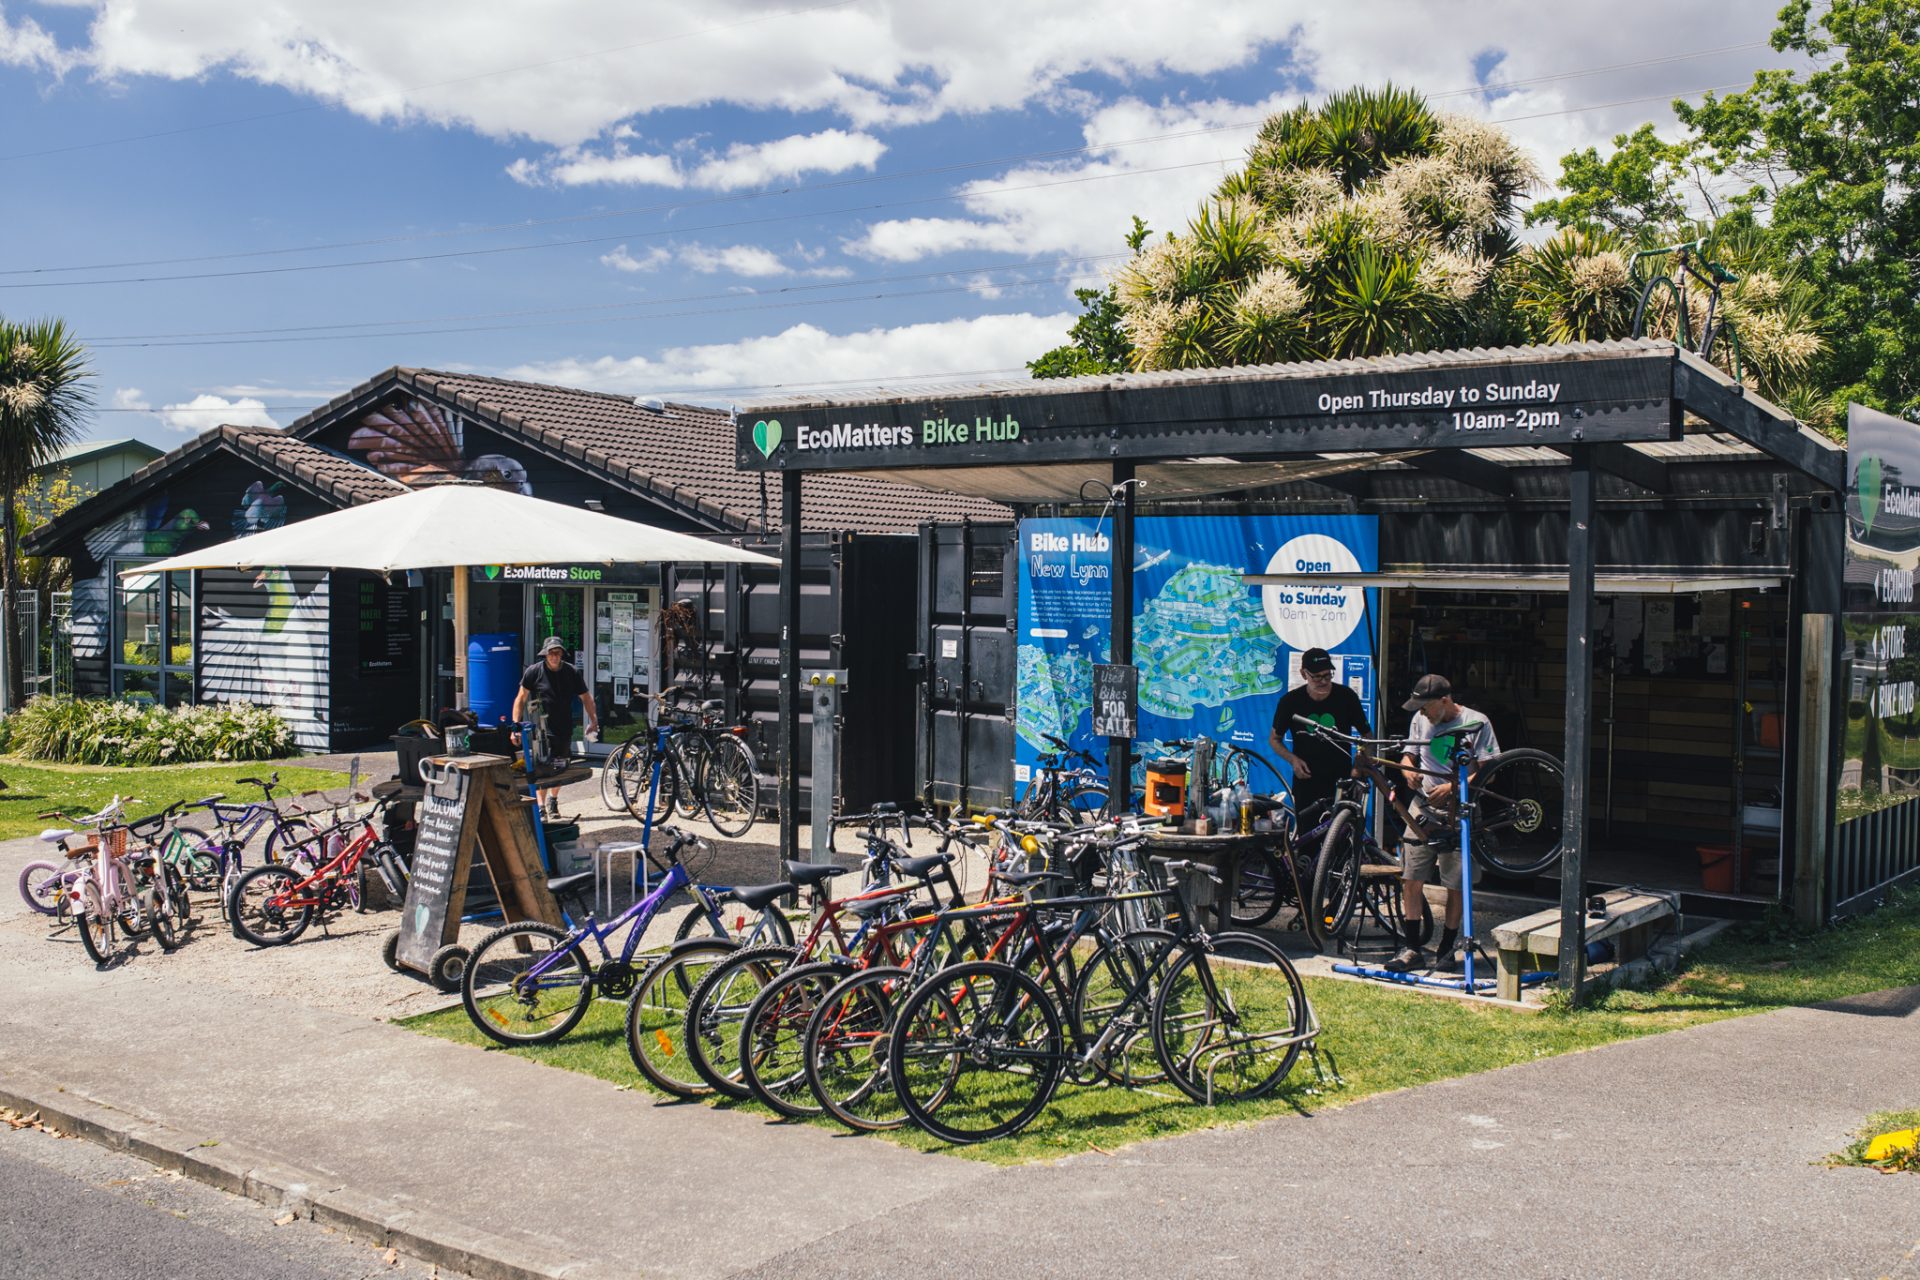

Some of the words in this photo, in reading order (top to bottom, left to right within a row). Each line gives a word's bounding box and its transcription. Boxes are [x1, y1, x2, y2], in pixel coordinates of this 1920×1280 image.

[1318, 394, 1363, 414] Open
[1369, 386, 1454, 408] Thursday
[1460, 386, 1479, 402] to
[1486, 380, 1560, 402] Sunday
[1452, 409, 1560, 431] 10am-2pm
[797, 423, 913, 449] EcoMatters
[923, 418, 968, 444] Bike
[975, 414, 1020, 442] Hub
[1031, 532, 1069, 552] Bike
[1072, 532, 1110, 552] Hub
[504, 566, 568, 579] EcoMatters
[570, 567, 602, 580] Store
[1031, 555, 1065, 577] New
[1070, 554, 1108, 586] Lynn
[1296, 559, 1331, 573] Open
[1882, 568, 1914, 603] ECOHUB
[1280, 593, 1293, 604] to
[1296, 593, 1346, 607] Sunday
[1279, 608, 1308, 620] 10am
[1321, 609, 1346, 622] 2pm
[1881, 625, 1907, 660] STORE
[1101, 670, 1125, 683] Used
[1099, 685, 1127, 700] Bikes
[1878, 683, 1898, 719] BIKE
[1898, 680, 1914, 715] HUB
[1102, 701, 1126, 717] FOR
[423, 795, 464, 819] WELCOME
